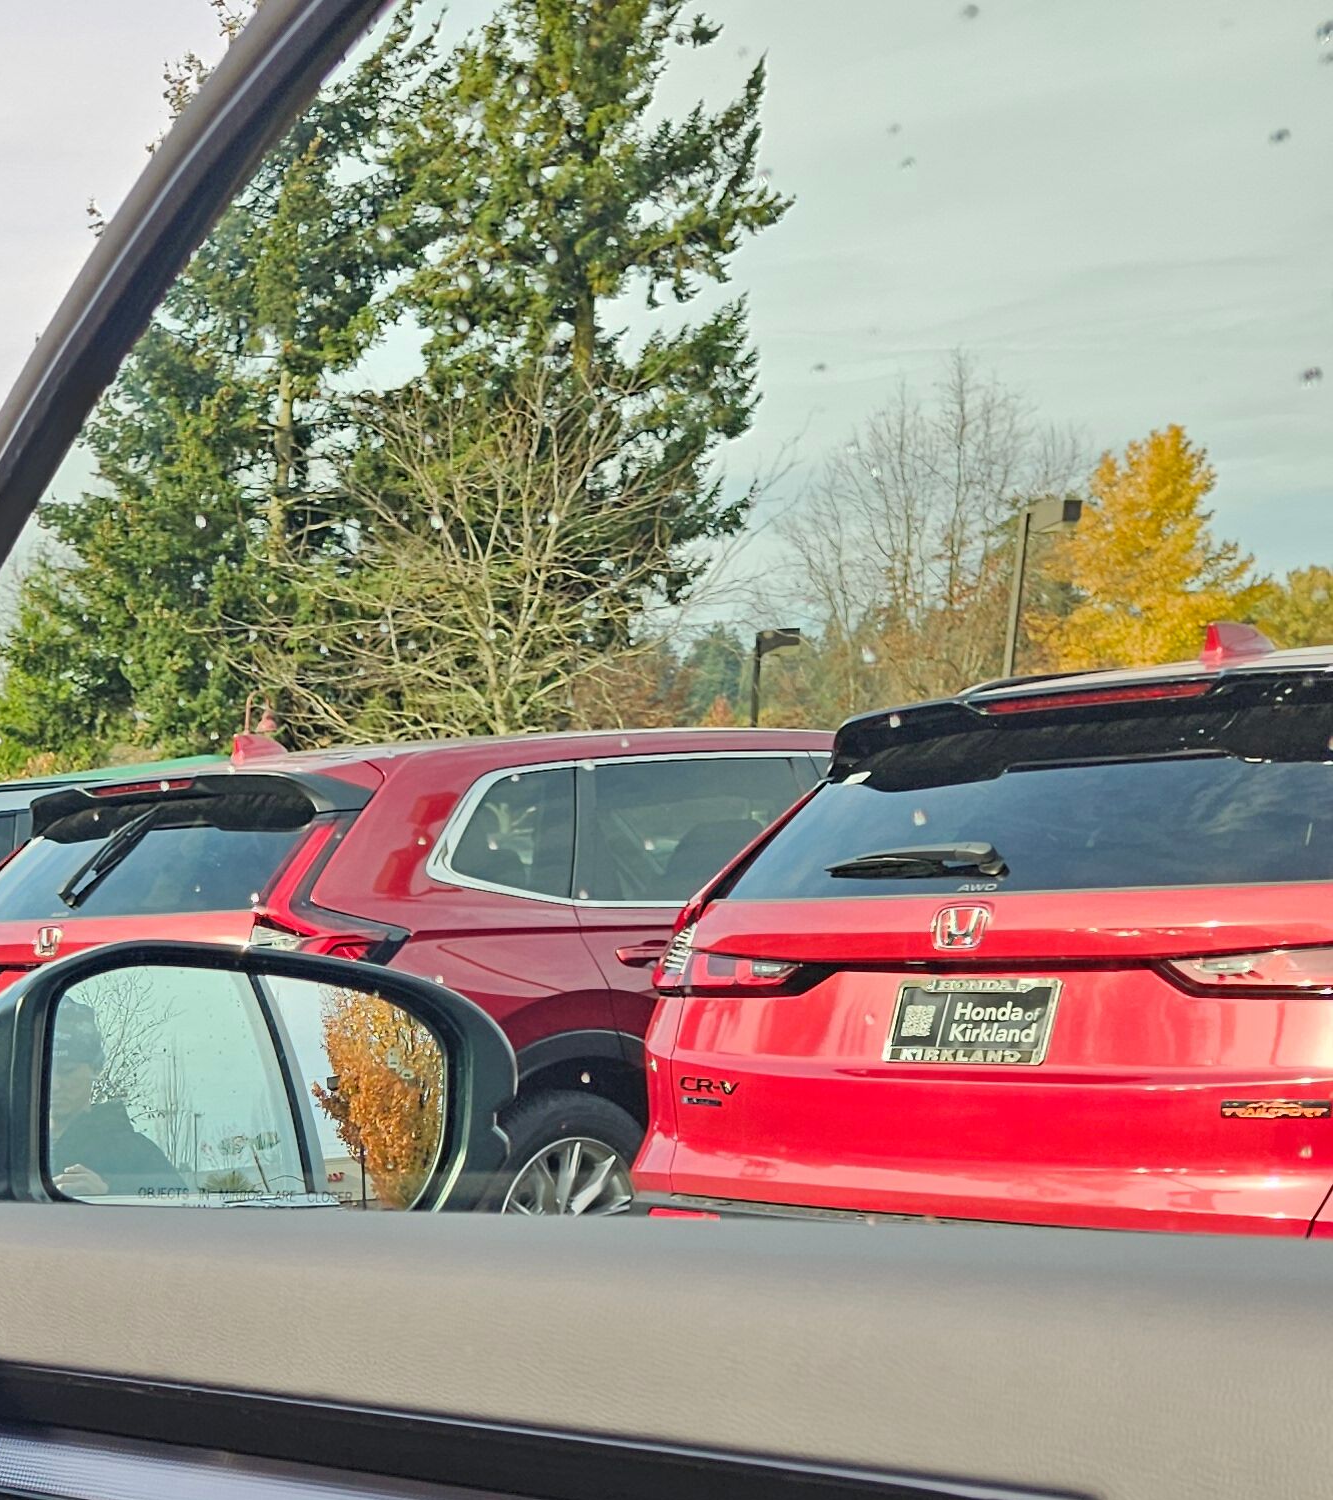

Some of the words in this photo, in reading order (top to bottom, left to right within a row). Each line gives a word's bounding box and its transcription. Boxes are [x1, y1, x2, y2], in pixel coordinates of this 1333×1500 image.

[956, 883, 998, 892] AWD
[953, 1001, 1023, 1022] Honda
[1024, 1008, 1041, 1022] of
[948, 1022, 1038, 1043] Kirkland
[899, 1048, 1022, 1063] KIRKLAND
[679, 1076, 740, 1095] CR-V
[138, 1187, 189, 1200] OBJECTS
[198, 1187, 210, 1200] IN
[307, 1191, 353, 1203] CLOSER
